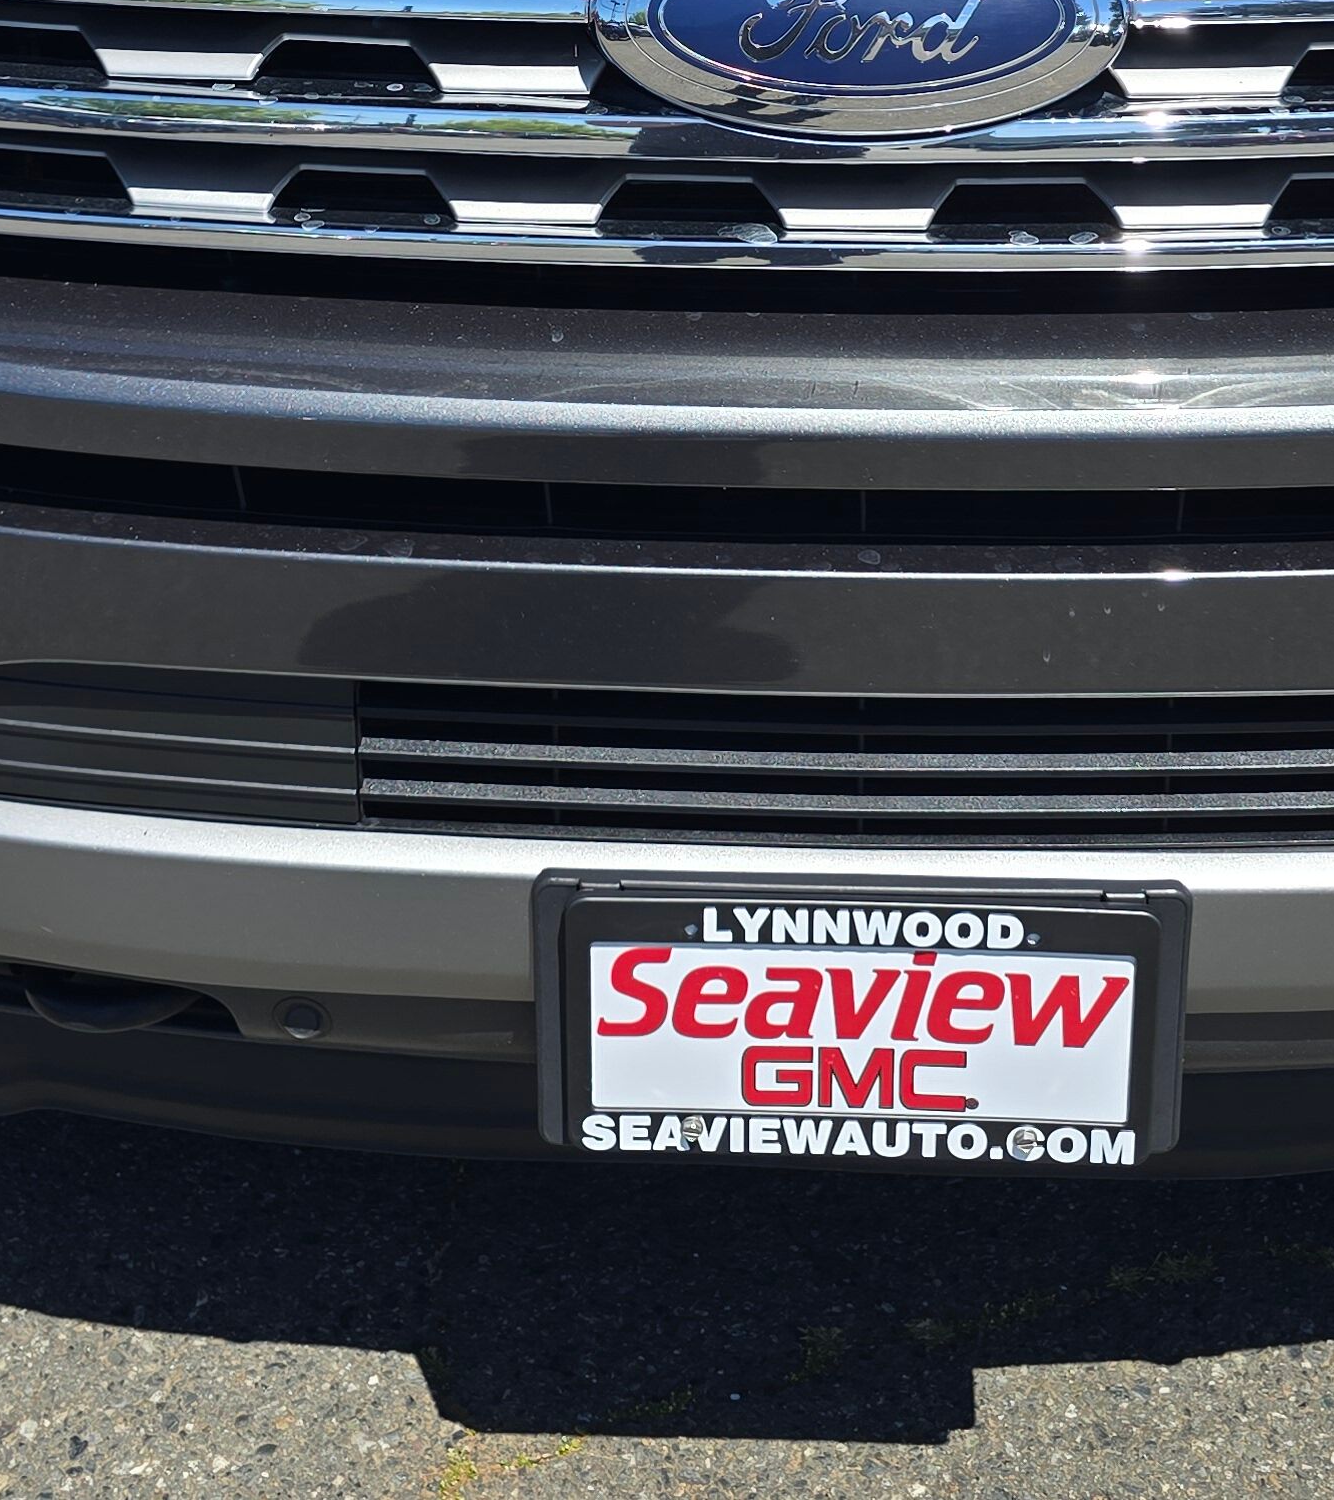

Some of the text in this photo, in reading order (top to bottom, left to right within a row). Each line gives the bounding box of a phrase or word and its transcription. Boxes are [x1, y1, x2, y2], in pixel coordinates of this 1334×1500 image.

[702, 907, 1025, 949] LYNNWOOD
[597, 946, 1130, 1049] Seaview
[741, 1045, 968, 1113] GMC
[581, 1114, 1137, 1166] SEAVIEWAUTO.COM
